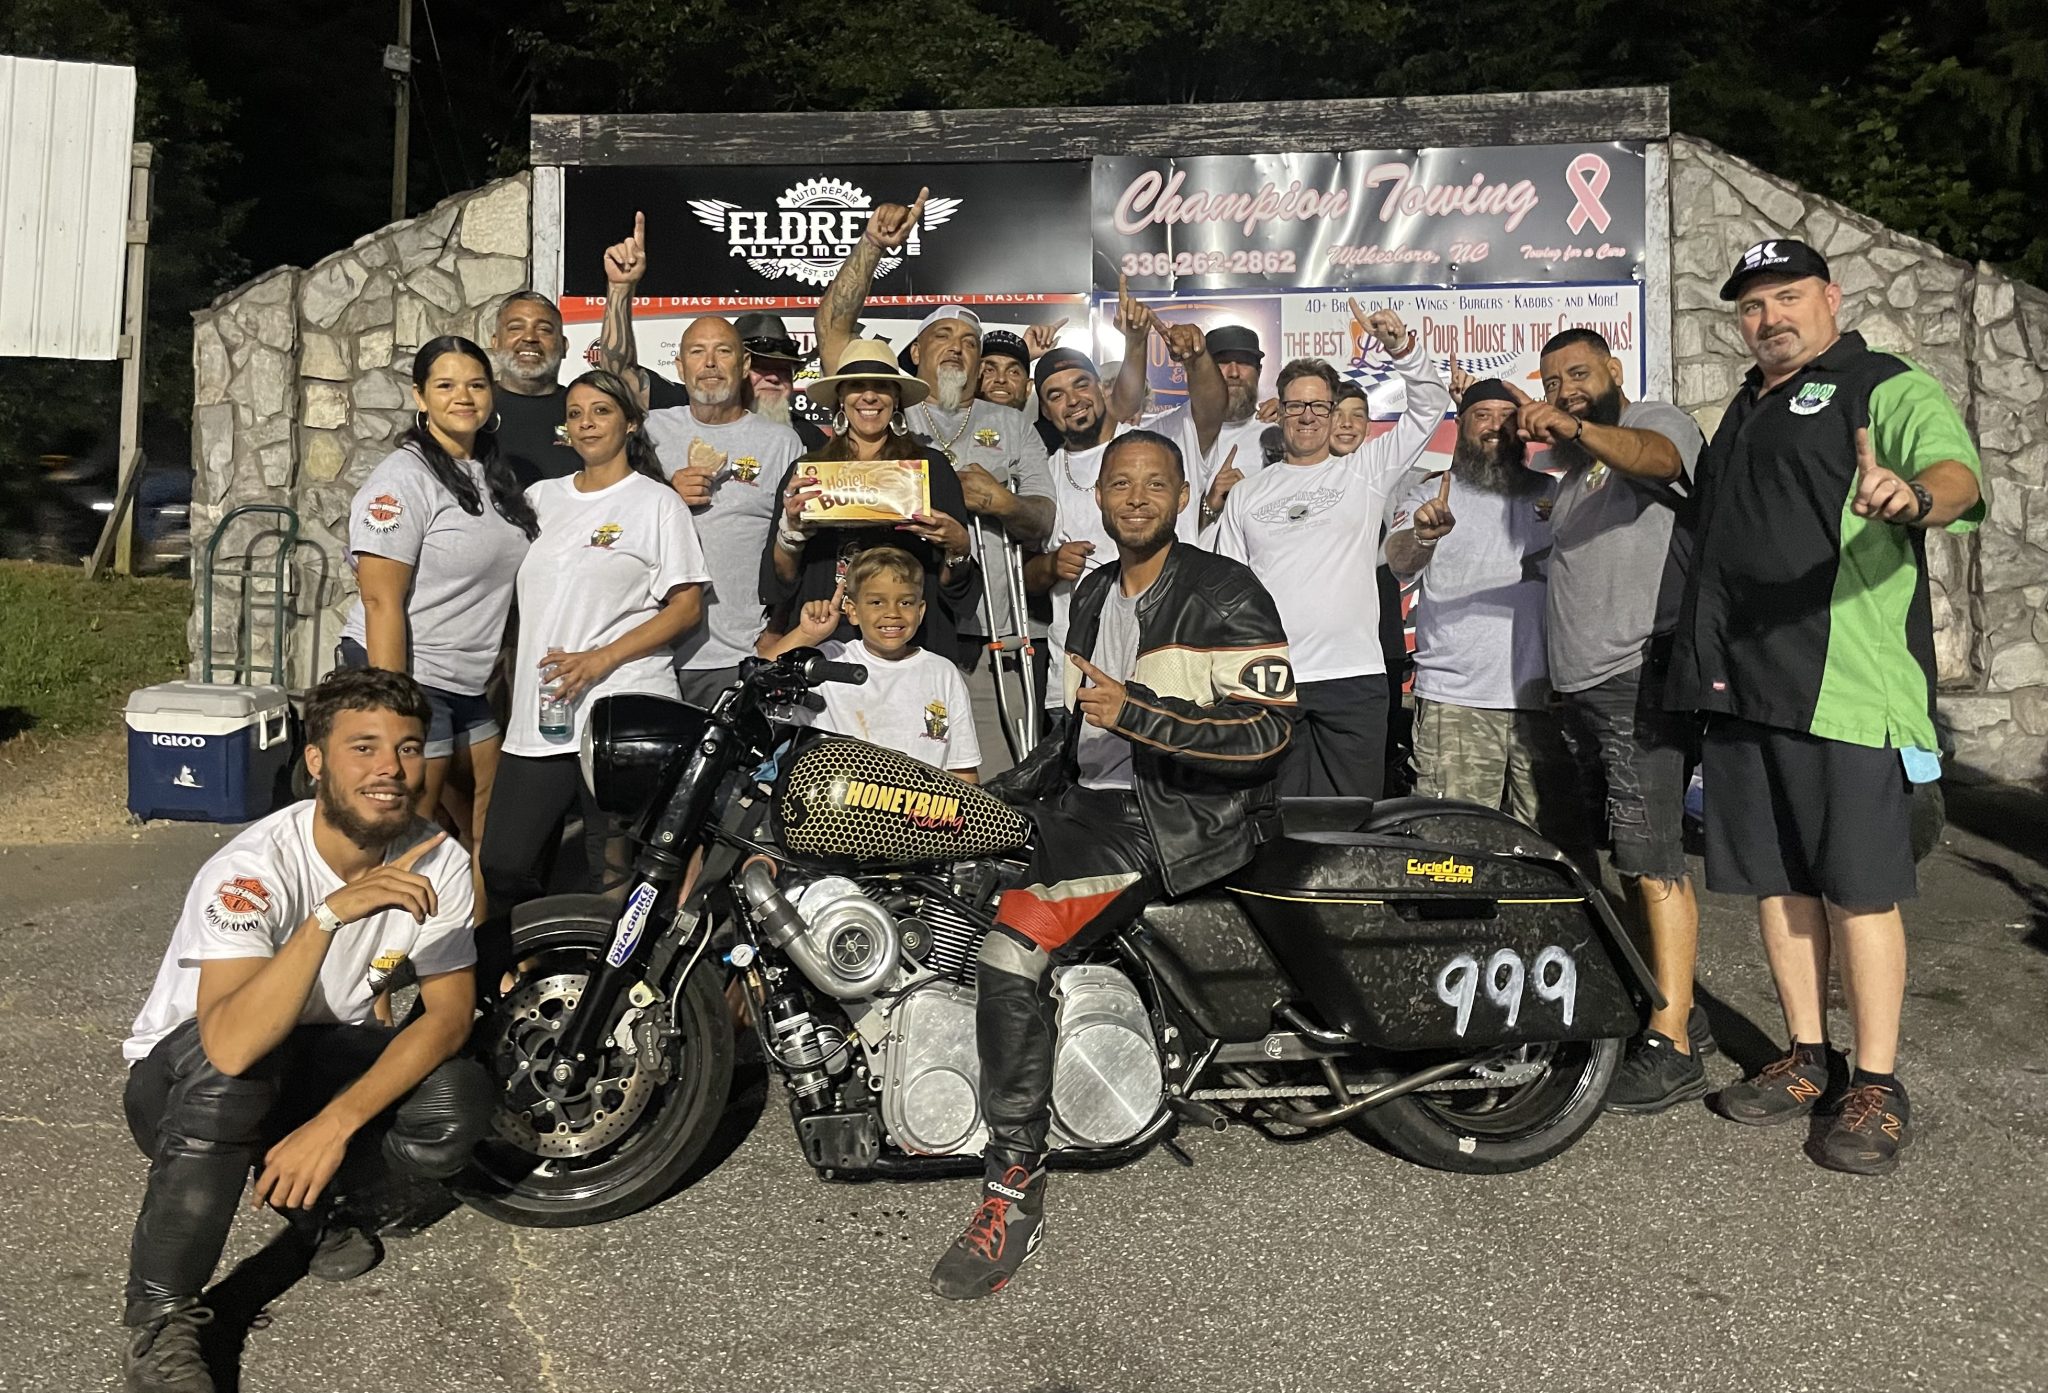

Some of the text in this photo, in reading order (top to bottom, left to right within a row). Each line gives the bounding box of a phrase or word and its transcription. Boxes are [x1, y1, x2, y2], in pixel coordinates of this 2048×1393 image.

[790, 186, 860, 205] AUTO REPAIR
[1113, 162, 1539, 237] Champion Towing
[728, 211, 921, 245] ELDRE
[729, 244, 921, 257] AUTOMOVE
[1121, 250, 1297, 276] 336-262-2862
[1450, 242, 1489, 263] NC
[1520, 244, 1562, 262] Towing
[1560, 244, 1582, 262] for
[1583, 247, 1594, 258] a
[671, 297, 712, 306] DRAG
[718, 296, 776, 305] RACING
[796, 296, 820, 305] CIR
[906, 294, 963, 304] RACING
[984, 293, 1044, 303] NASCAR
[1305, 298, 1328, 313] 40+
[1388, 297, 1404, 311] TAP
[1415, 297, 1449, 311] WINGS
[1459, 296, 1503, 310] BURGERS
[1514, 294, 1553, 309] KABOBS
[1564, 296, 1583, 307] AND
[1587, 292, 1619, 307] MORE!
[1284, 332, 1311, 357] THE
[1314, 332, 1345, 357] BEST
[1422, 315, 1459, 354] POUR
[1464, 315, 1507, 353] HOUSE
[1512, 323, 1524, 352] IN
[1530, 322, 1552, 352] THE
[826, 474, 867, 490] Honey
[1252, 665, 1288, 692] 17
[152, 733, 206, 748] IGLOO
[844, 781, 960, 820] HONEYBUN
[906, 808, 966, 834] Racing
[611, 885, 651, 965] DRAGBIKE
[1436, 945, 1578, 1038] 999
